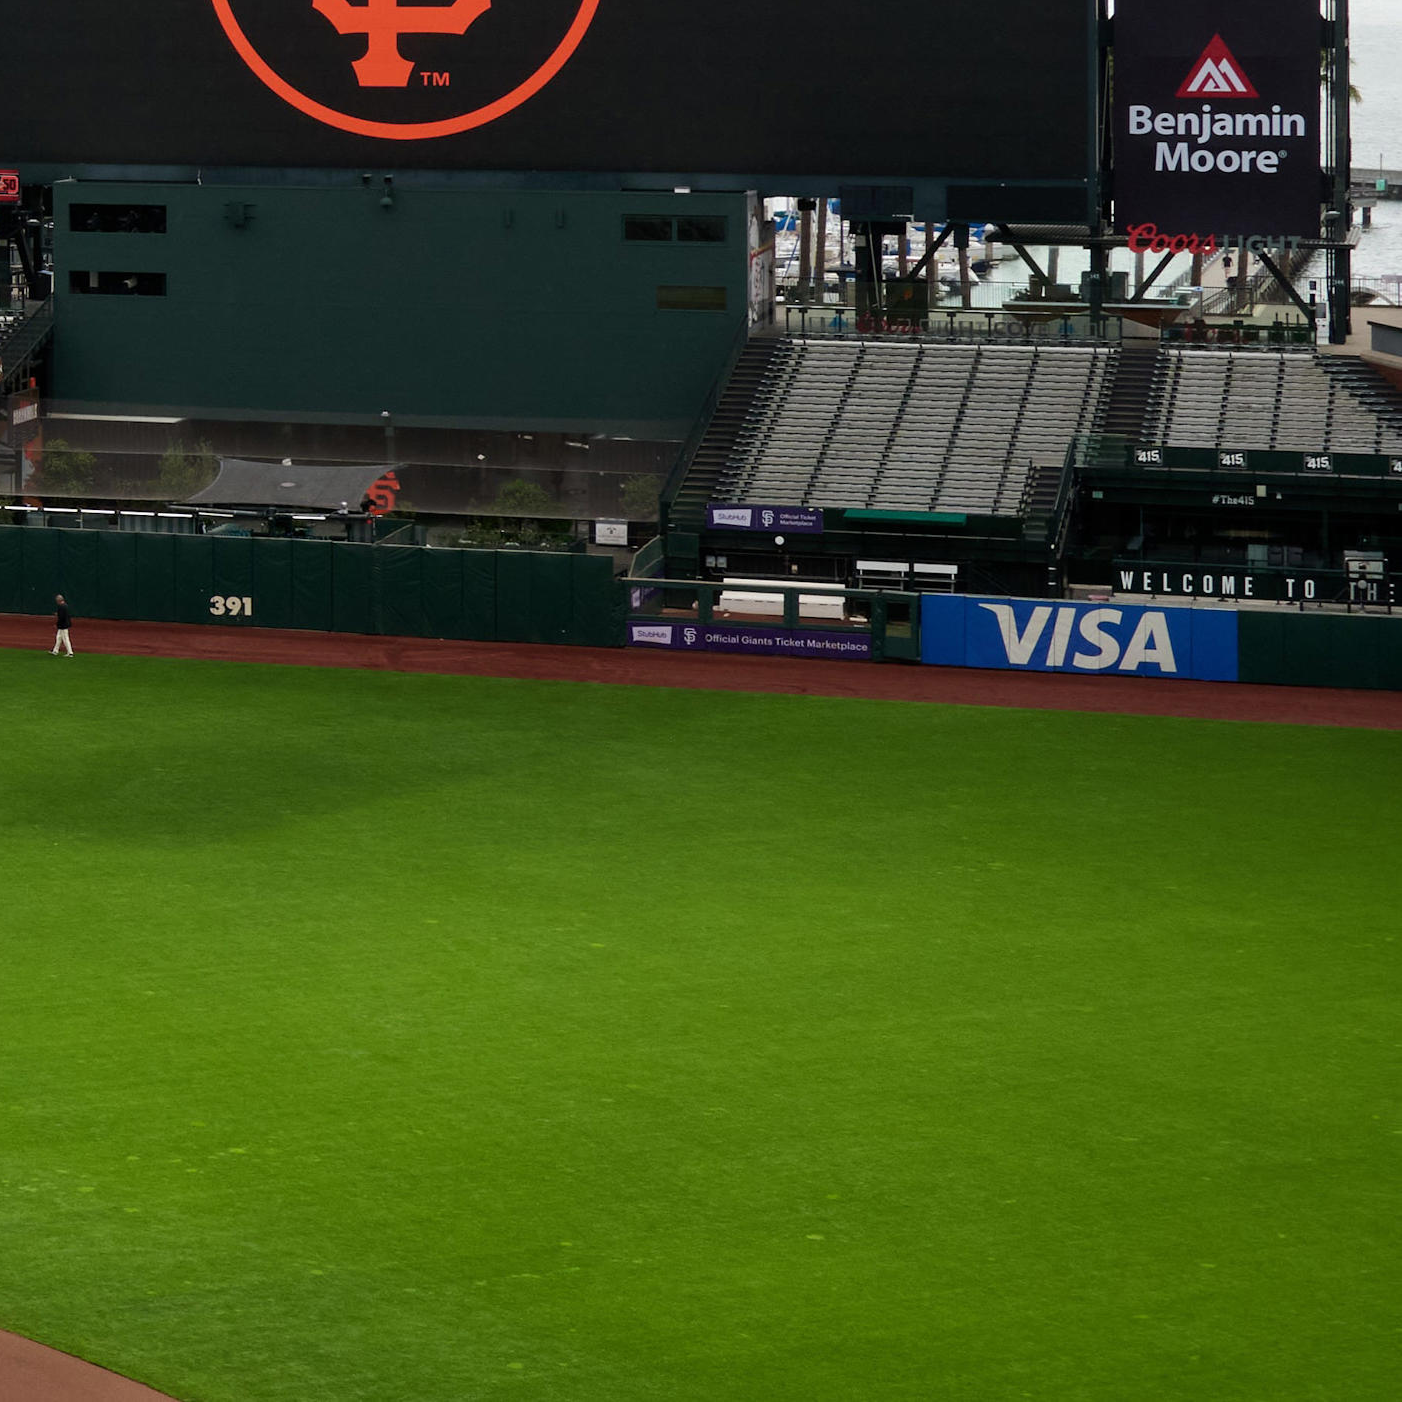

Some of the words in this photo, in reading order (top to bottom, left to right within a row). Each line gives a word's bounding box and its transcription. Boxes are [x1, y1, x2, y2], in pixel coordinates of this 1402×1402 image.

[420, 71, 451, 87] TM
[1128, 103, 1306, 144] Benjamin
[1126, 223, 1219, 255] Coors
[1223, 234, 1302, 255] LIGHT
[1138, 450, 1159, 462] 415
[1222, 453, 1244, 466] 415
[1307, 456, 1330, 469] 415
[1212, 495, 1255, 505] #The415
[1121, 571, 1253, 597] WELCOME
[1286, 578, 1315, 599] TO
[209, 595, 253, 617] 391
[705, 633, 739, 645] Official
[742, 635, 773, 647] Giants
[775, 636, 805, 648] Ticket
[807, 638, 868, 653] Marketplace
[978, 603, 1177, 673] VISA
